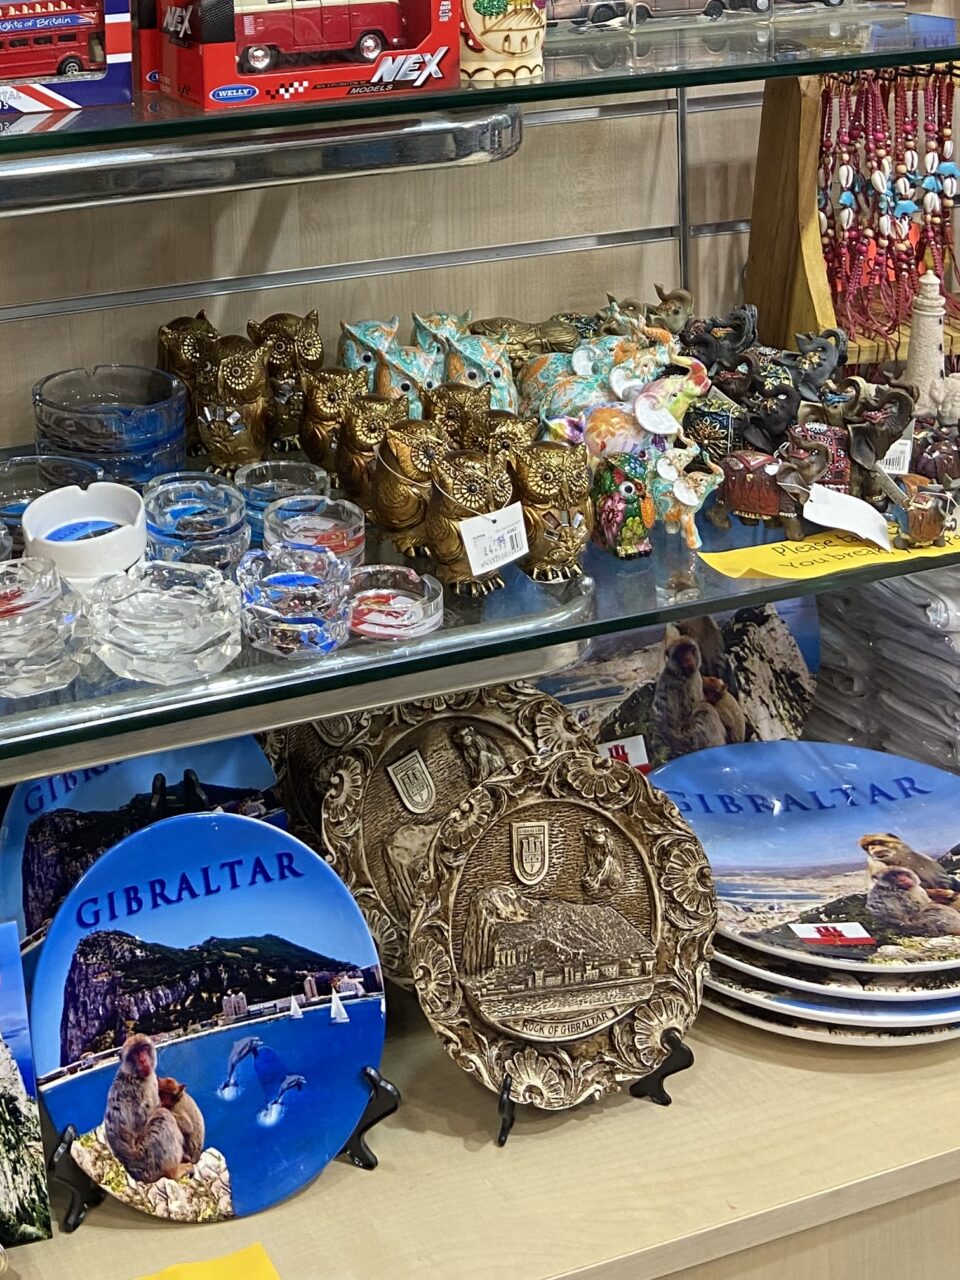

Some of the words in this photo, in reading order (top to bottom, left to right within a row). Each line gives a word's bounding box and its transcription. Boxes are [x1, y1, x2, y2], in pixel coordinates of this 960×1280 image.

[24, 19, 35, 28] of
[36, 16, 71, 28] Britain
[164, 5, 193, 38] NEX
[371, 47, 448, 86] NEX
[218, 88, 249, 98] WELLY
[350, 84, 393, 94] MODELS
[772, 537, 834, 556] Please
[779, 557, 826, 569] You
[76, 851, 305, 929] GIBRALTAR
[522, 1019, 546, 1032] ROCK
[548, 1023, 559, 1035] OF
[560, 1012, 610, 1035] GIBRALTAR
